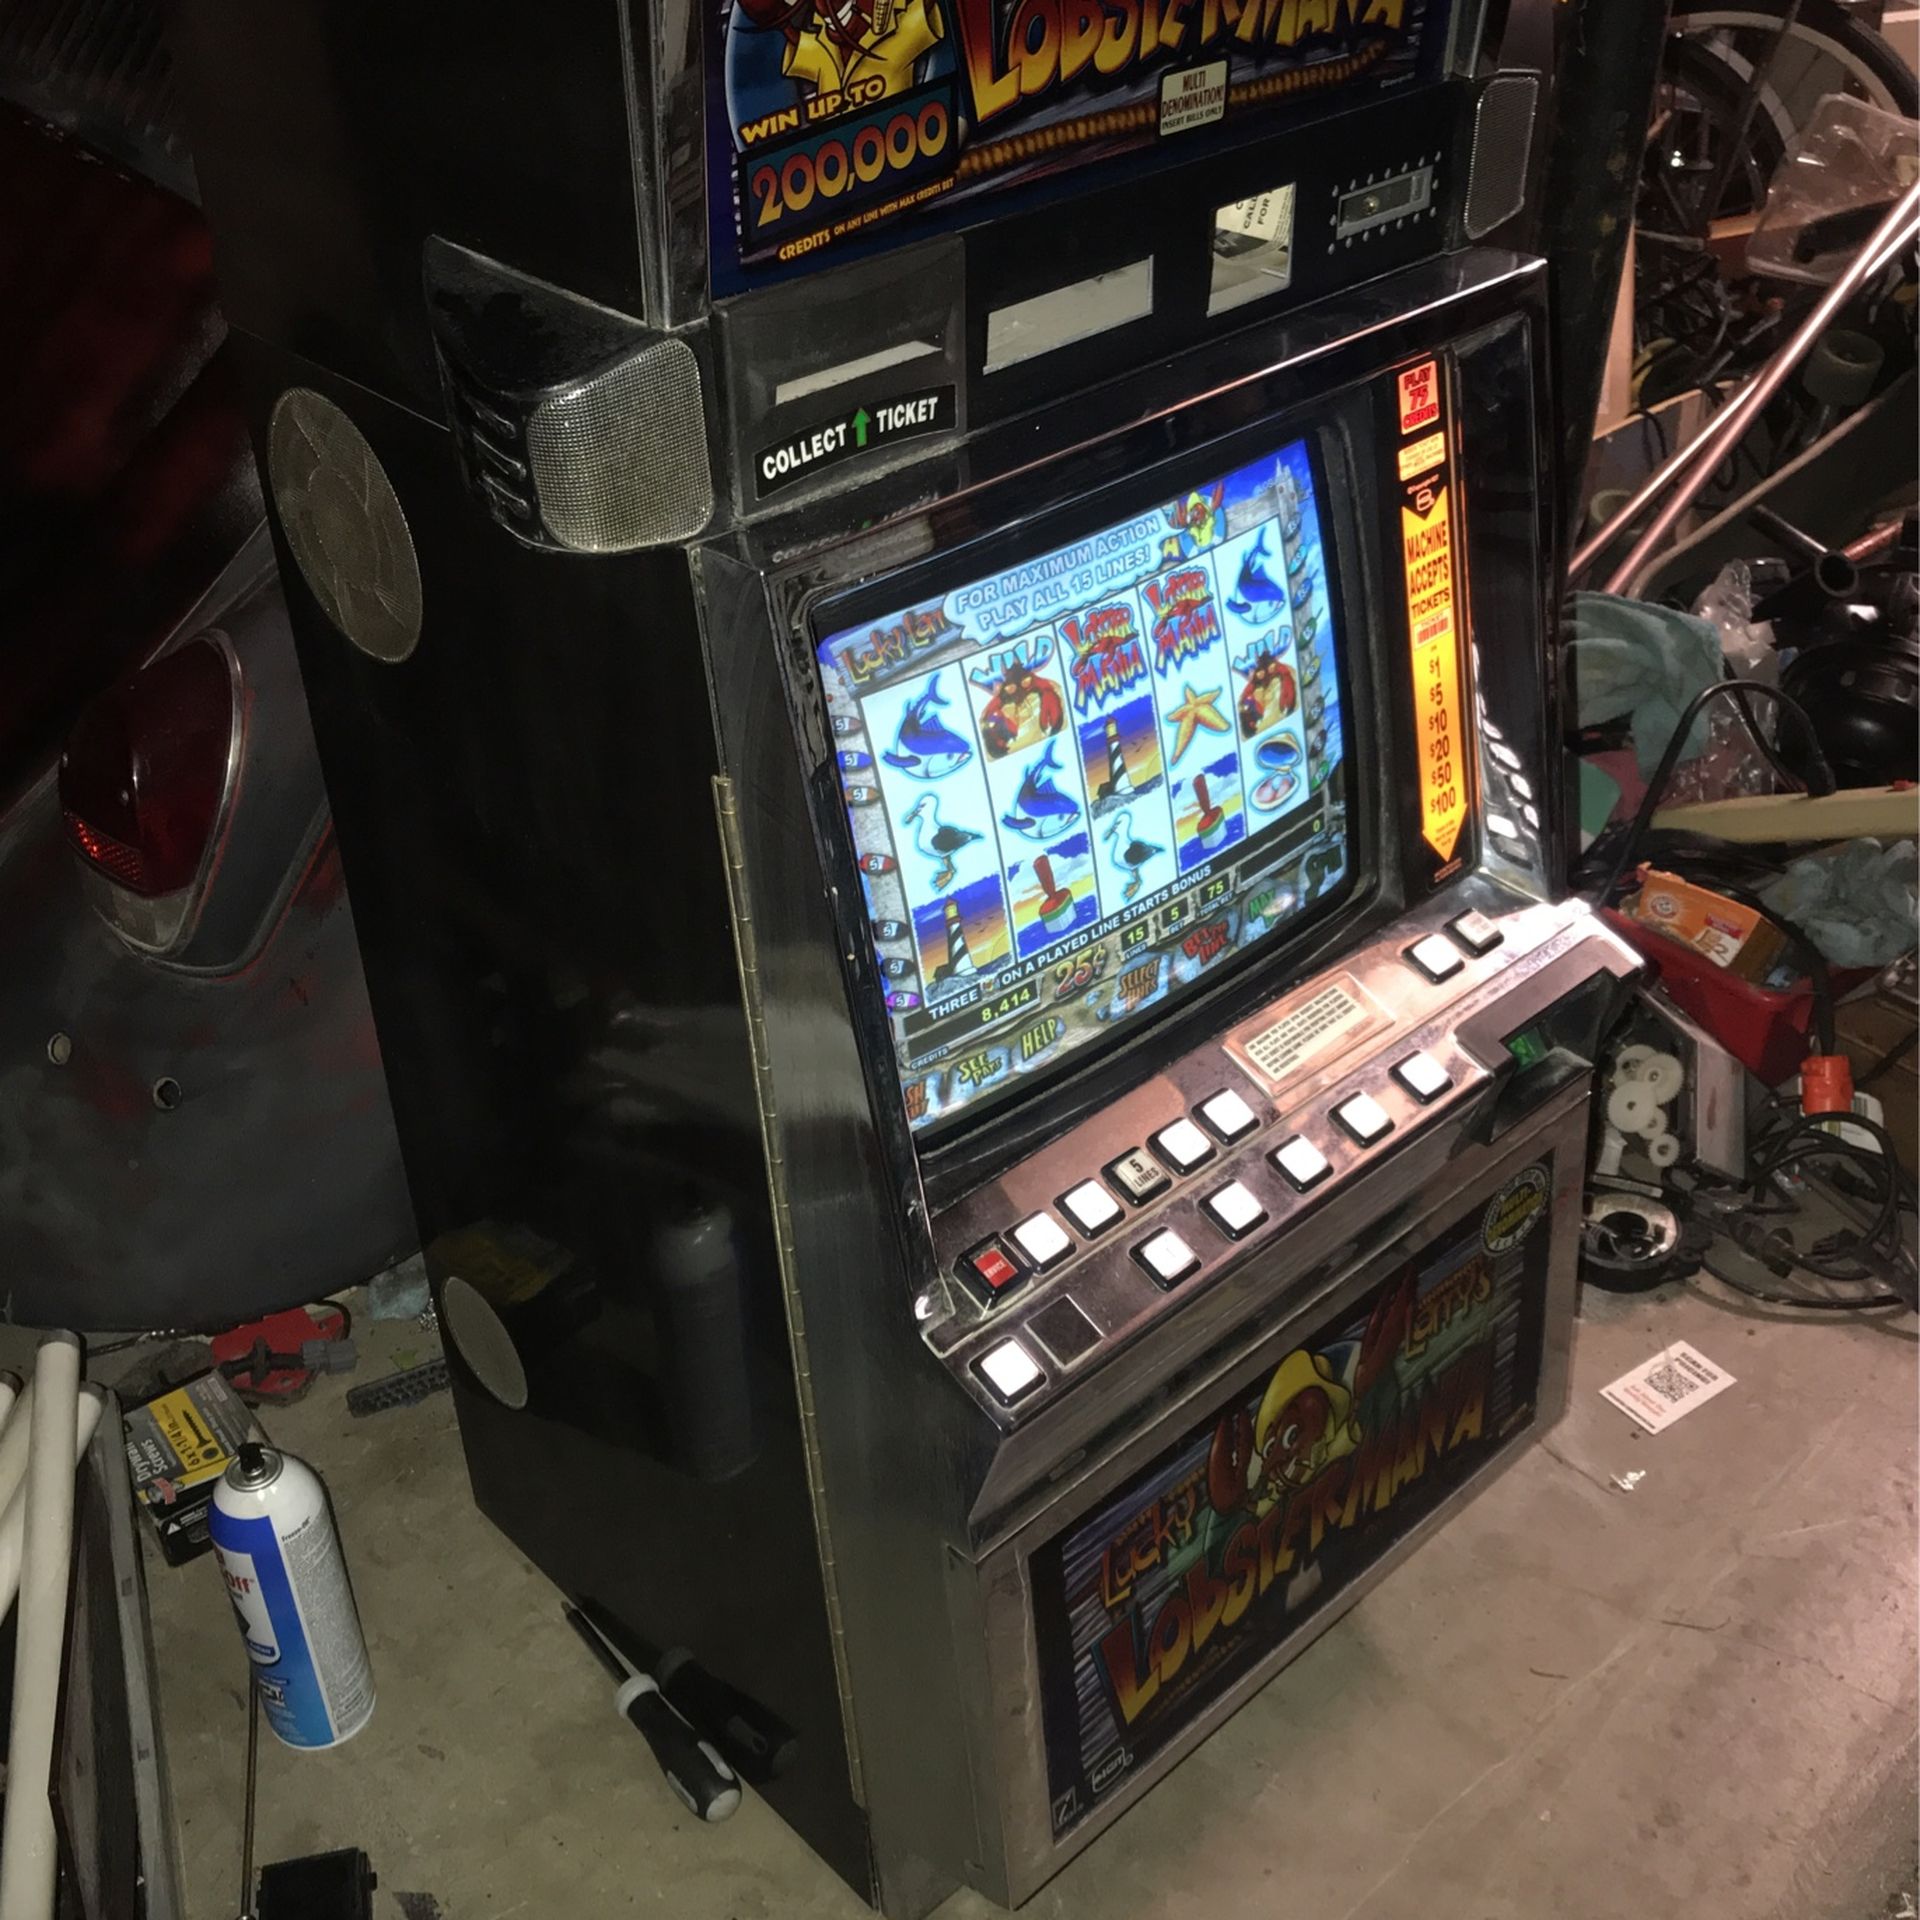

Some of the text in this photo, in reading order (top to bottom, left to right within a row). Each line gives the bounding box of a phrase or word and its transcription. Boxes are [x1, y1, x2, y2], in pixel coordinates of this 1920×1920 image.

[1182, 70, 1207, 92] MULTI
[741, 78, 884, 143] WIN UP TO
[1161, 105, 1222, 130] INSERT BILLS ONLY
[752, 101, 948, 227] 200,000
[779, 229, 831, 261] CREDITS
[833, 223, 846, 236] ON
[847, 215, 863, 231] ANY
[863, 209, 879, 225] LINE
[880, 201, 899, 217] WITH
[899, 194, 915, 208] MAX
[1404, 365, 1431, 390] PLAY
[1408, 385, 1430, 411] 75
[763, 396, 939, 480] COLLECT TICKET
[1407, 520, 1448, 565] MACHINE
[957, 517, 1160, 613] FOR MAXIMUM ACTION
[1409, 554, 1449, 595] ACCEPTS
[979, 544, 1150, 630] PLAY ALL 15 LINES!
[1412, 587, 1450, 619] TICKETS
[1429, 656, 1440, 678] $1
[1430, 682, 1443, 706] $5
[1429, 709, 1447, 735] $10
[1430, 735, 1450, 762] $20
[1431, 761, 1452, 788] $50
[1431, 786, 1456, 816] $100
[1313, 820, 1320, 832] 0
[1127, 880, 1224, 944] 15 5 75
[929, 866, 1211, 1020] THREE ON A PLAYED LINE STARTS BONUS
[1056, 943, 1107, 997] 25¢
[1022, 1019, 1057, 1059] HELP
[959, 1053, 988, 1083] SEE
[1128, 1159, 1143, 1174] 5
[1133, 1166, 1160, 1187] LINES
[141, 1438, 168, 1475] Screws
